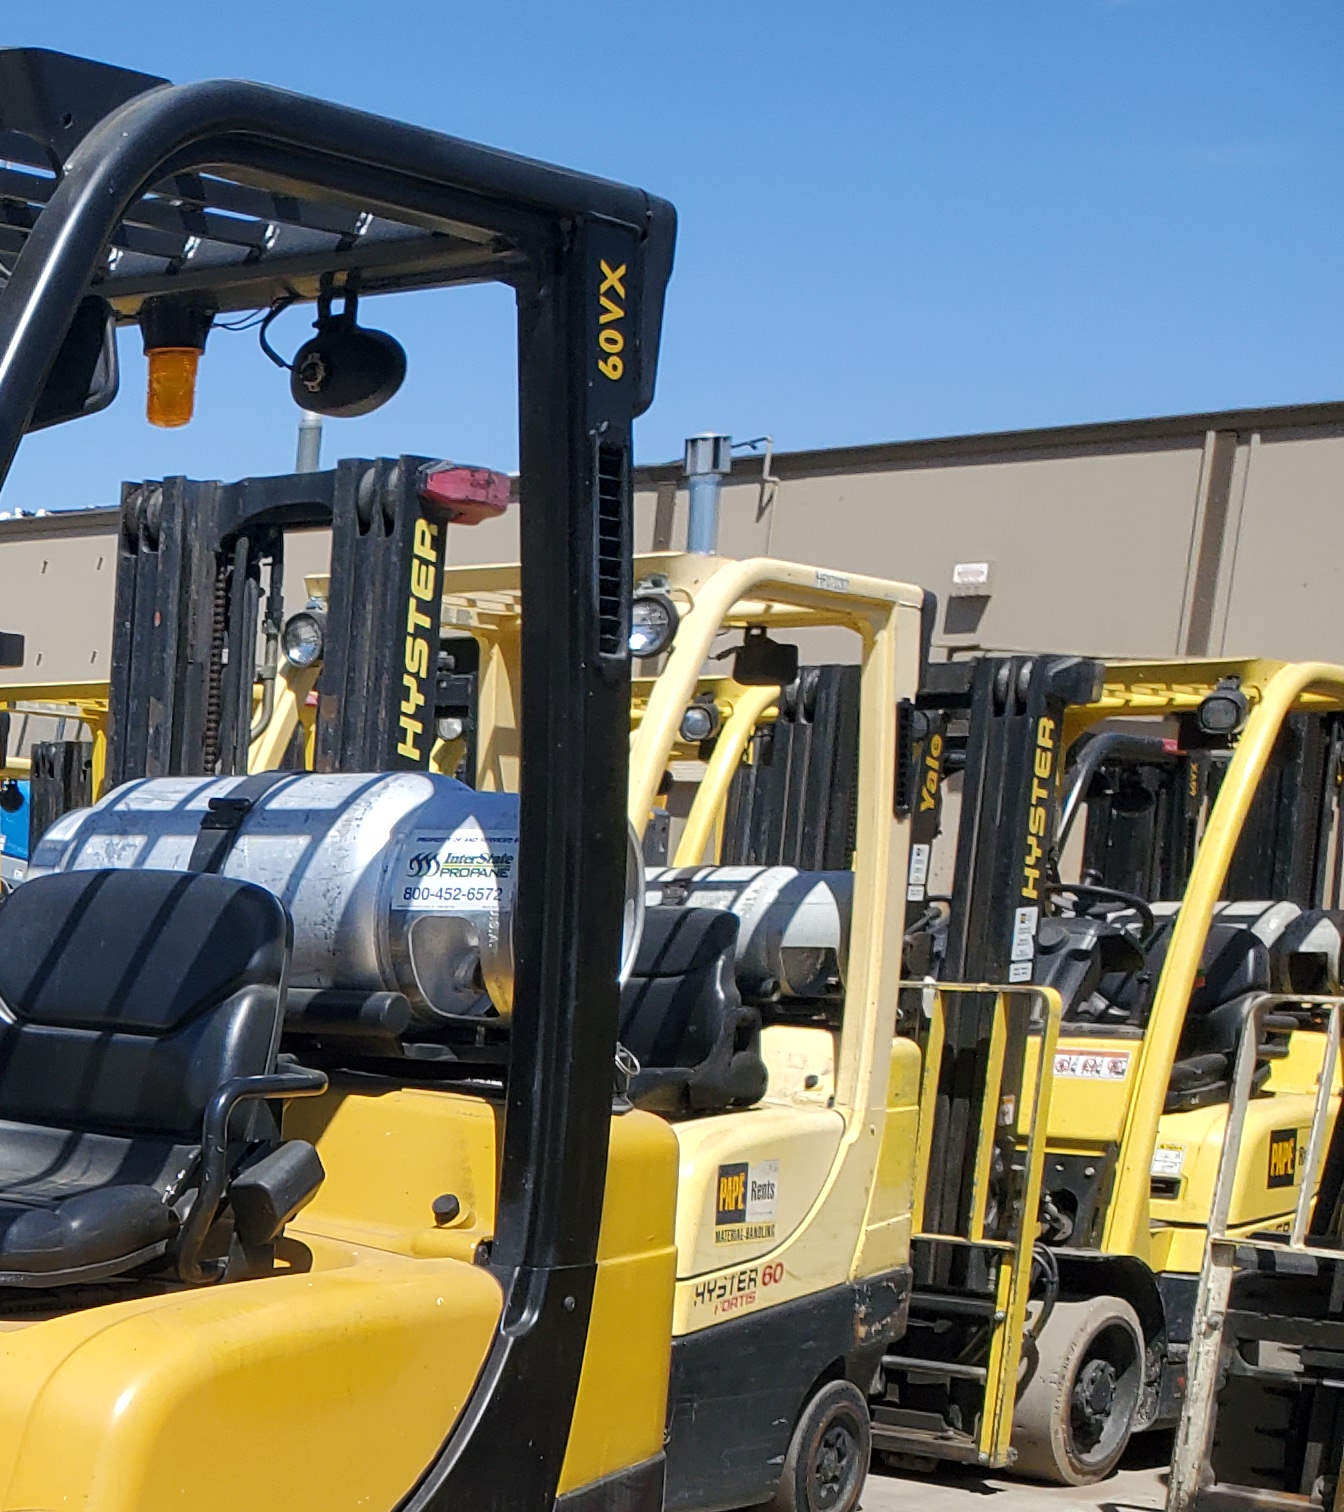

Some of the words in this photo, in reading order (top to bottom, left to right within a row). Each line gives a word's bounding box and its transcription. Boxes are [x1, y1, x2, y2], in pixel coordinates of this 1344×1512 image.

[598, 258, 627, 380] 60VX
[397, 518, 438, 761] HYSTER
[920, 733, 943, 812] Yale
[1022, 716, 1055, 899] HYSTER
[443, 852, 514, 865] InterState
[440, 867, 511, 878] PROPANE
[403, 887, 503, 901] 800-452-6572
[750, 1180, 776, 1202] Rents
[762, 1261, 784, 1287] 60
